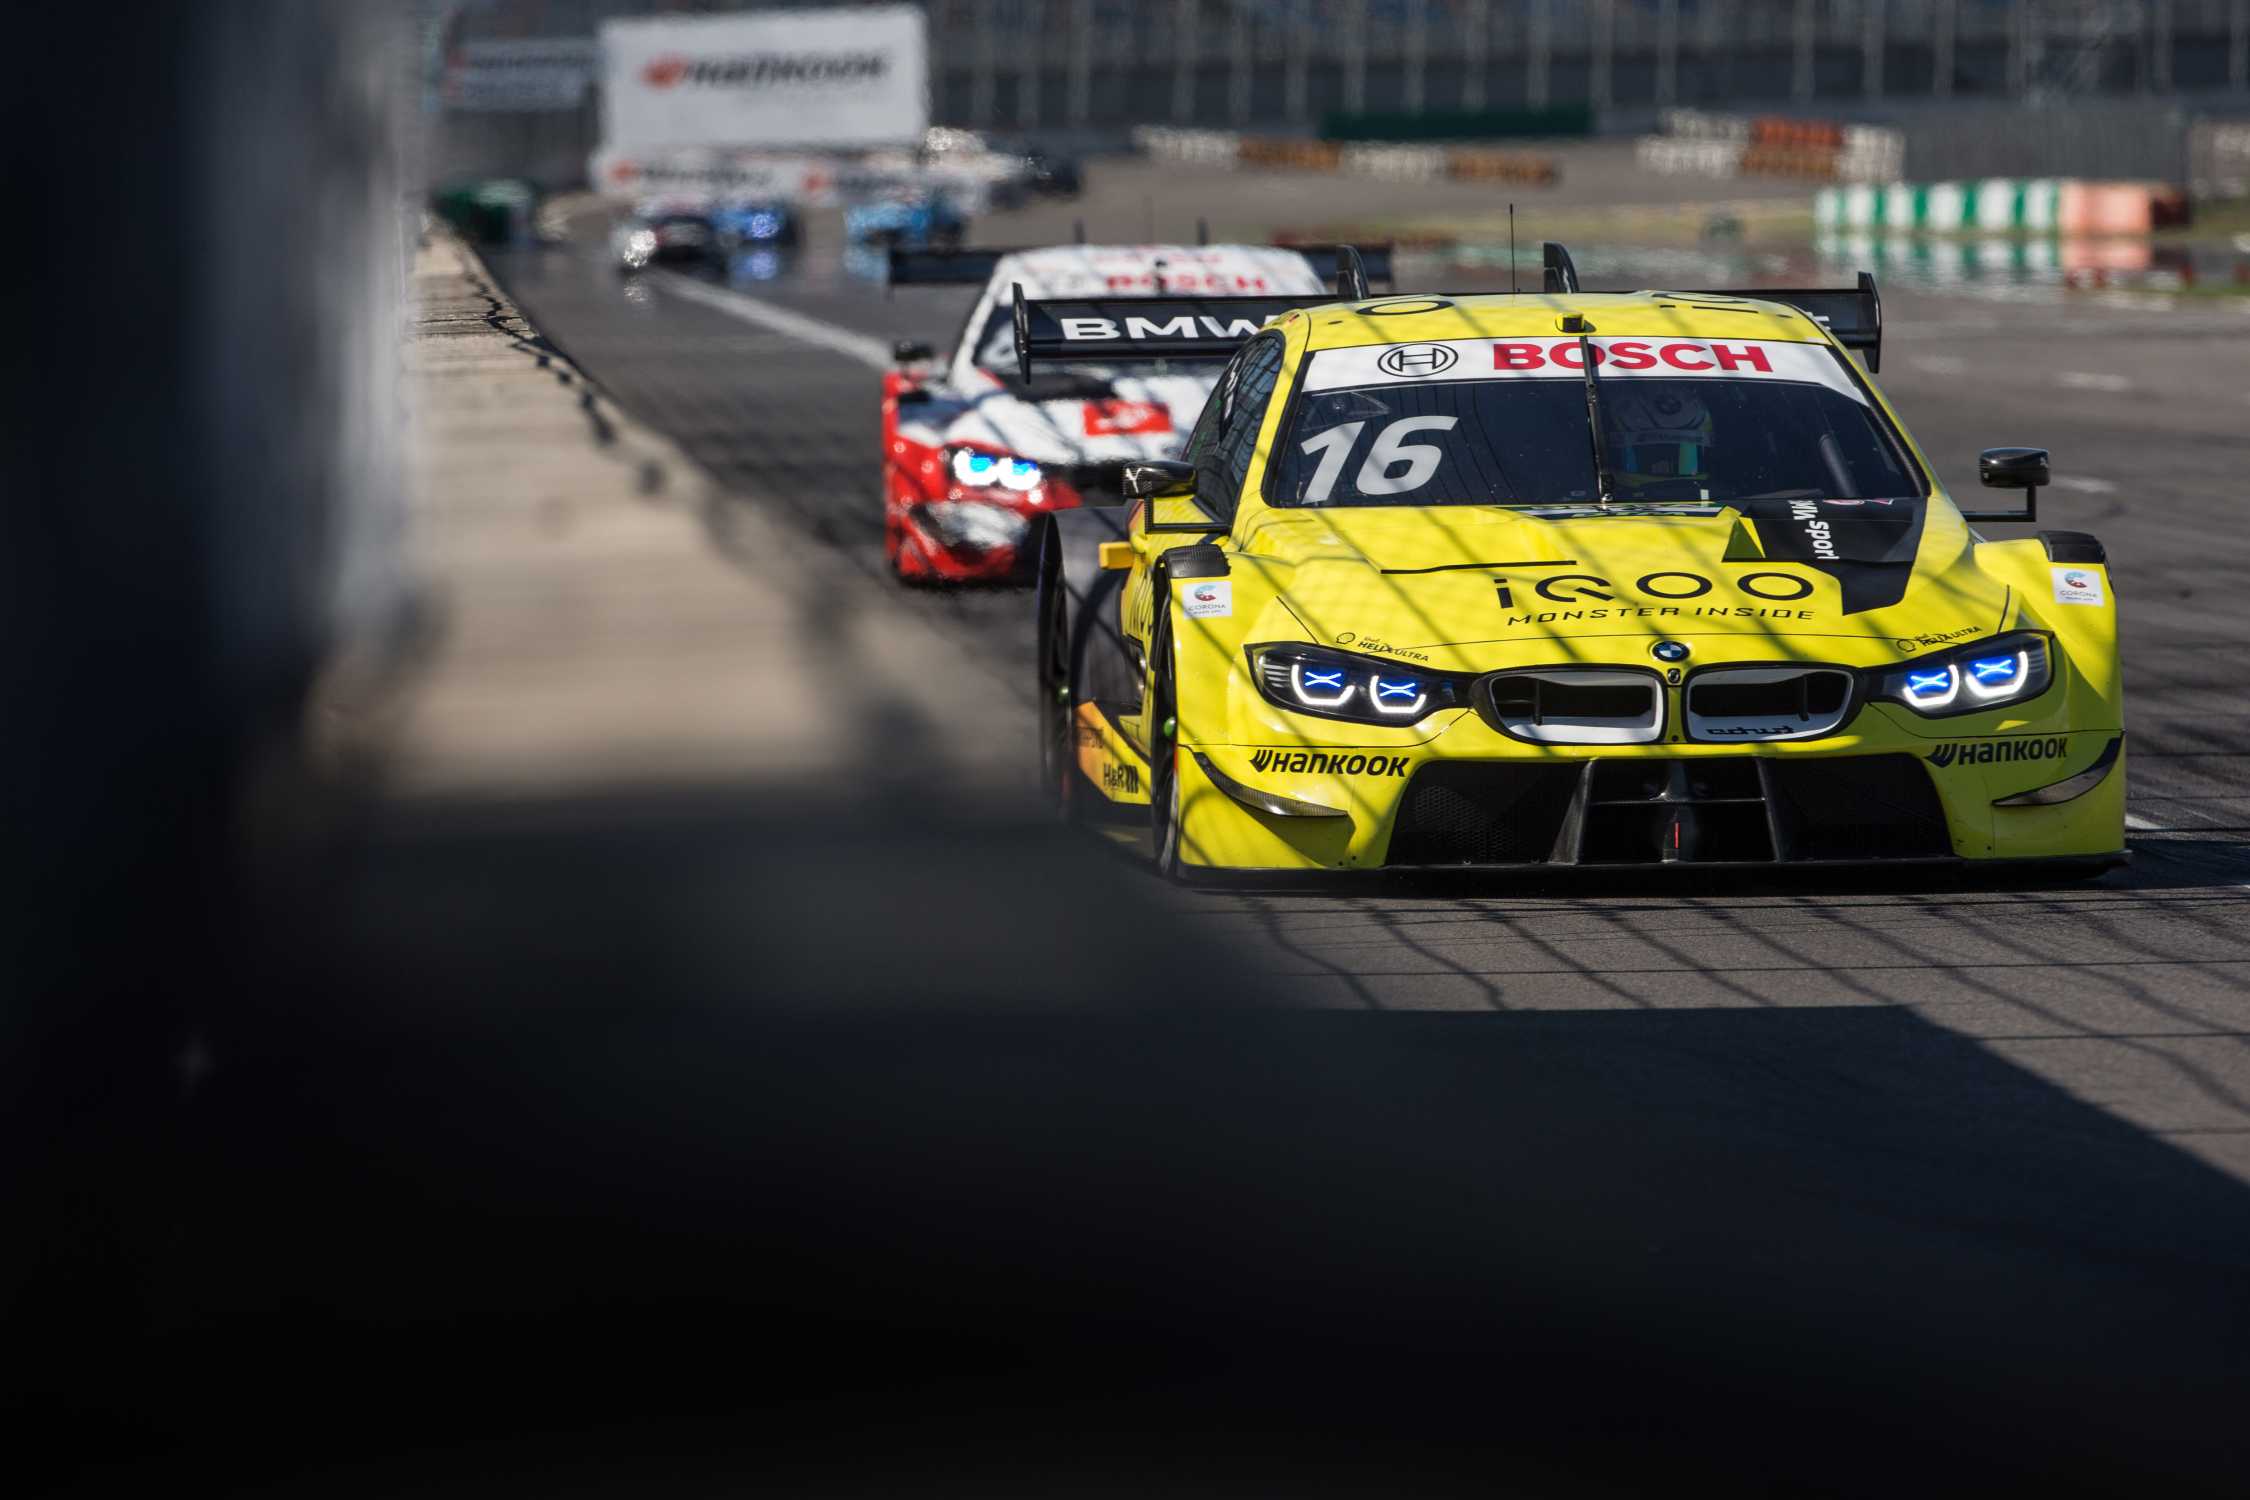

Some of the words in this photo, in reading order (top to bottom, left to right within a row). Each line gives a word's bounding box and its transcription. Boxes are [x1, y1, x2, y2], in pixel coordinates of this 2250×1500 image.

[1060, 315, 1280, 340] BMW
[1493, 342, 1773, 373] BOSCH
[1301, 415, 1459, 504] 16
[1494, 571, 1814, 609] iQOO
[1507, 607, 1679, 626] MONSTER
[1695, 607, 1816, 620] INSIDE
[1394, 648, 1430, 662] ULTRA
